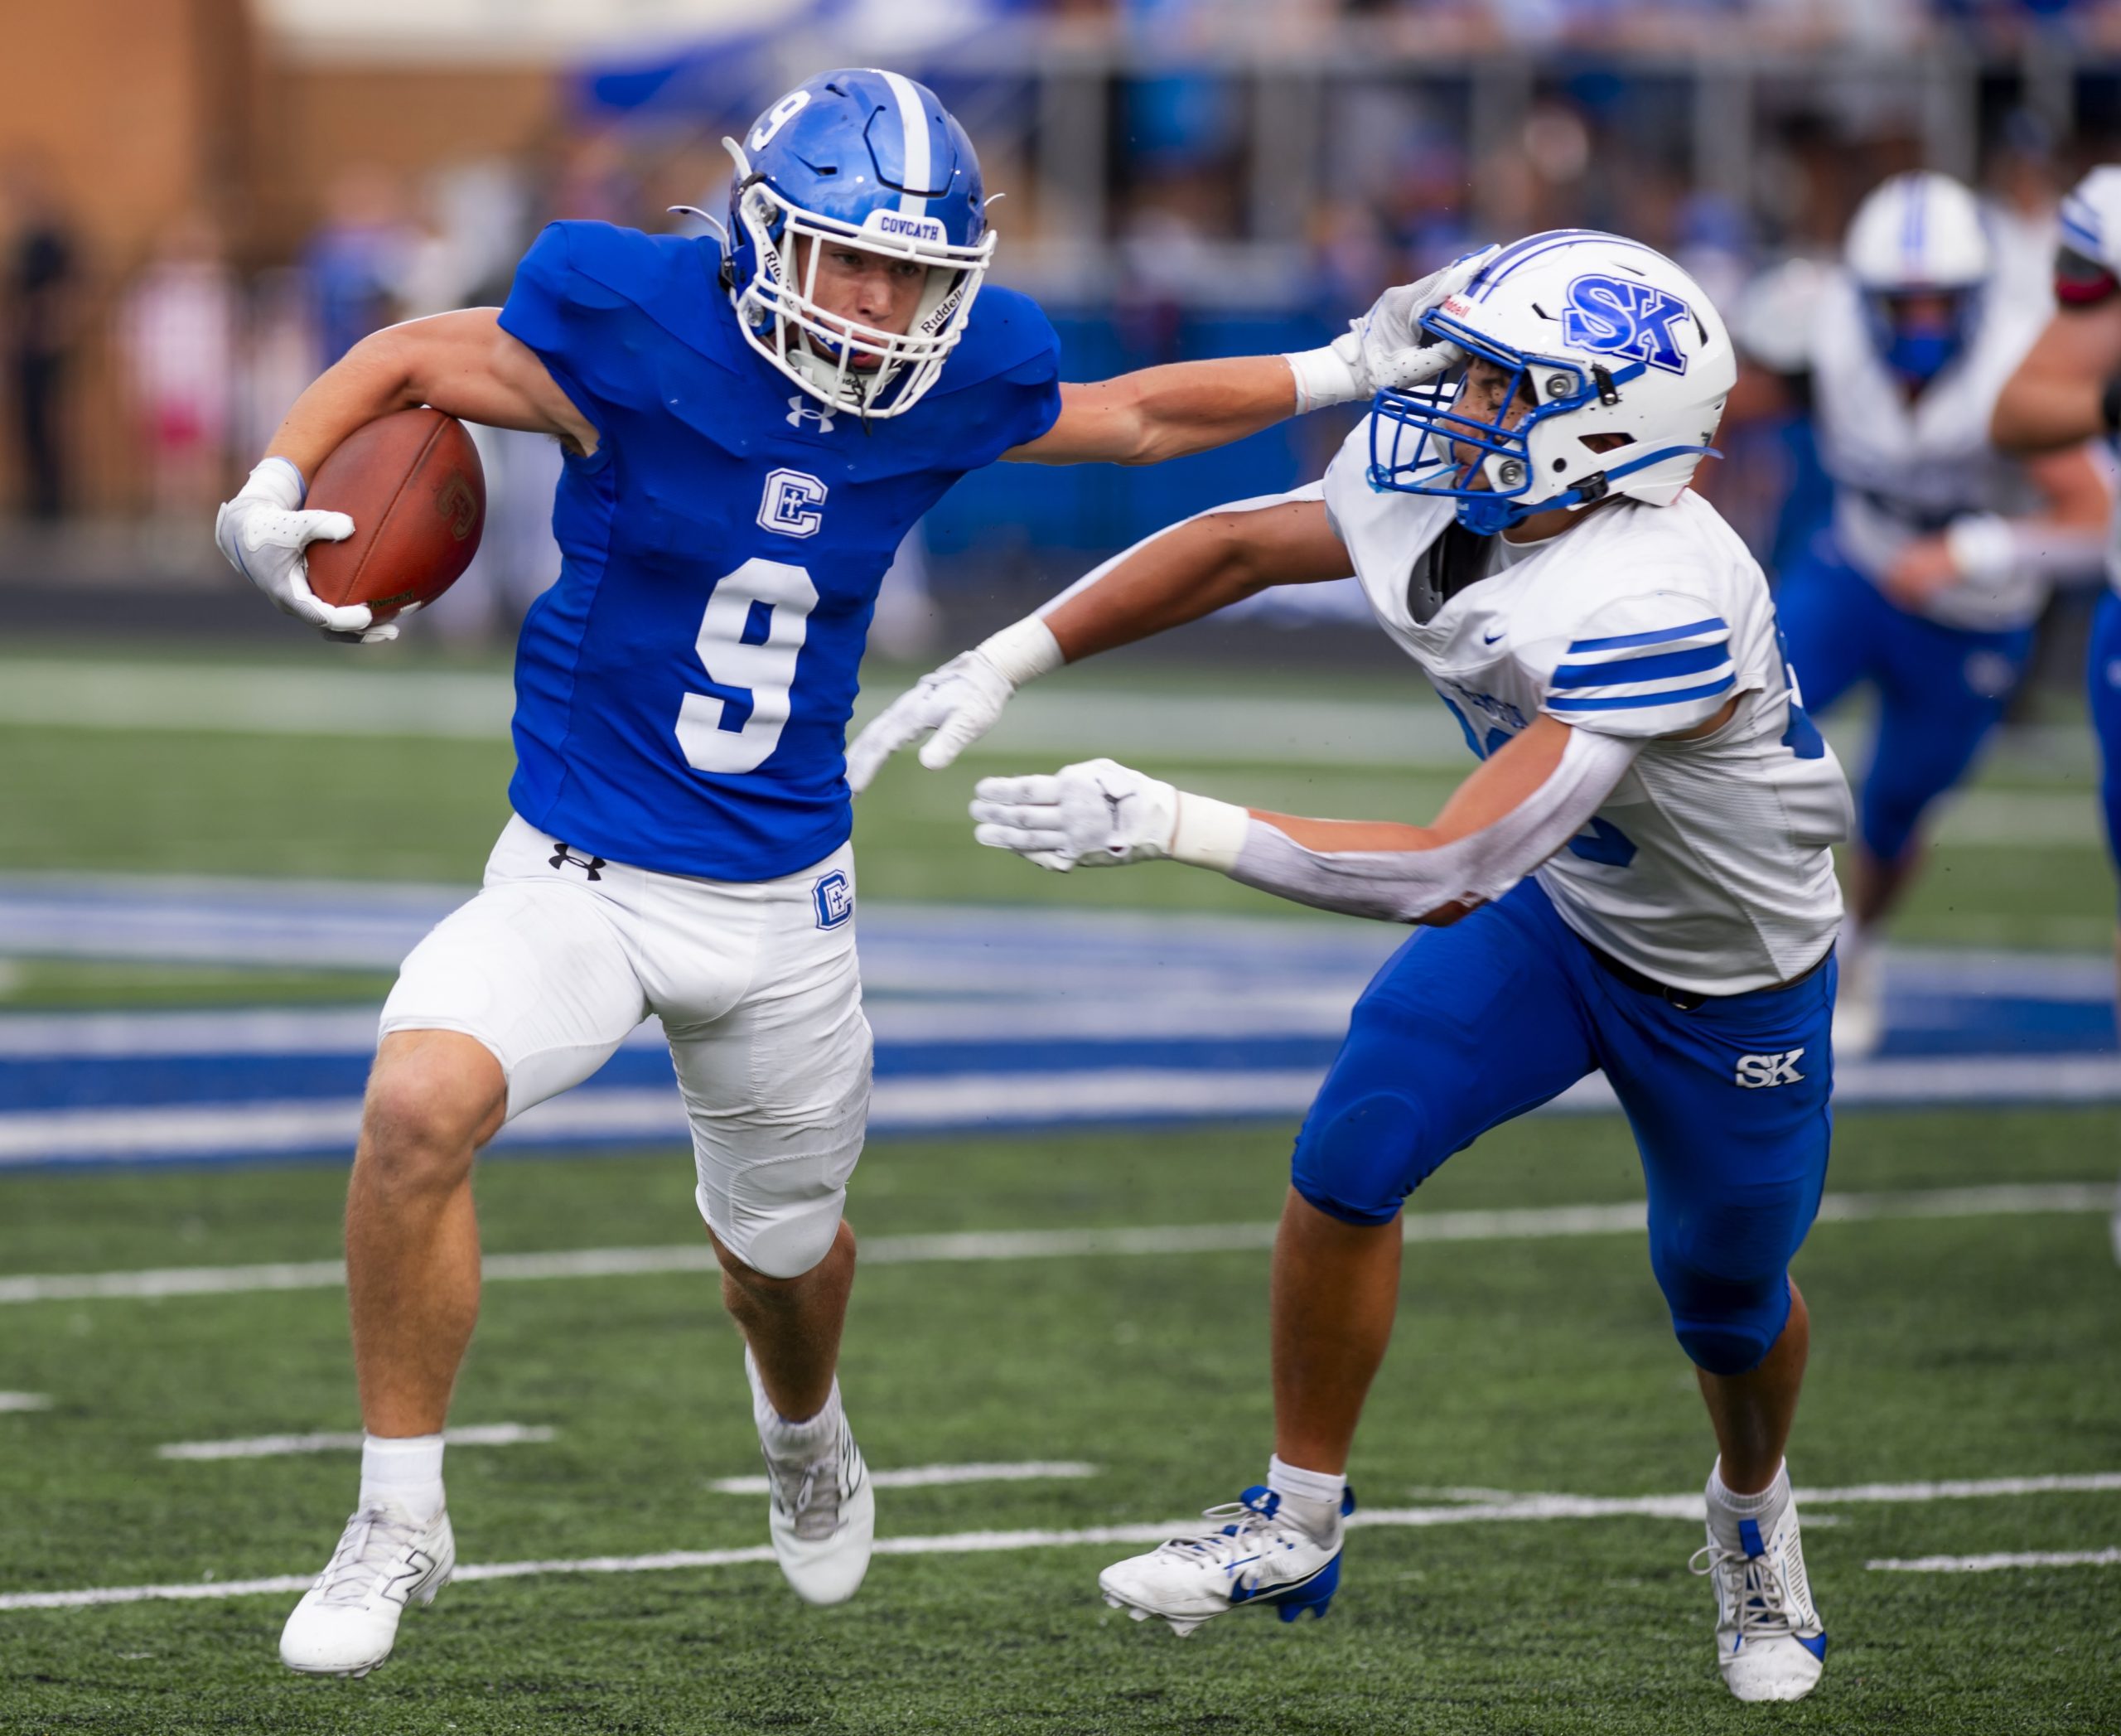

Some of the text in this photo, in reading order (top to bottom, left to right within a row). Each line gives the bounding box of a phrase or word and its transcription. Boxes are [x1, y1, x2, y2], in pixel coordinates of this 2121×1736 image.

[751, 89, 812, 152] 9
[881, 216, 940, 241] COVCATH
[920, 290, 964, 334] Riddell
[1563, 273, 1690, 377] SK
[756, 467, 829, 539] C
[674, 557, 820, 775] 9
[811, 868, 854, 931] C
[1735, 1047, 1806, 1089] SK
